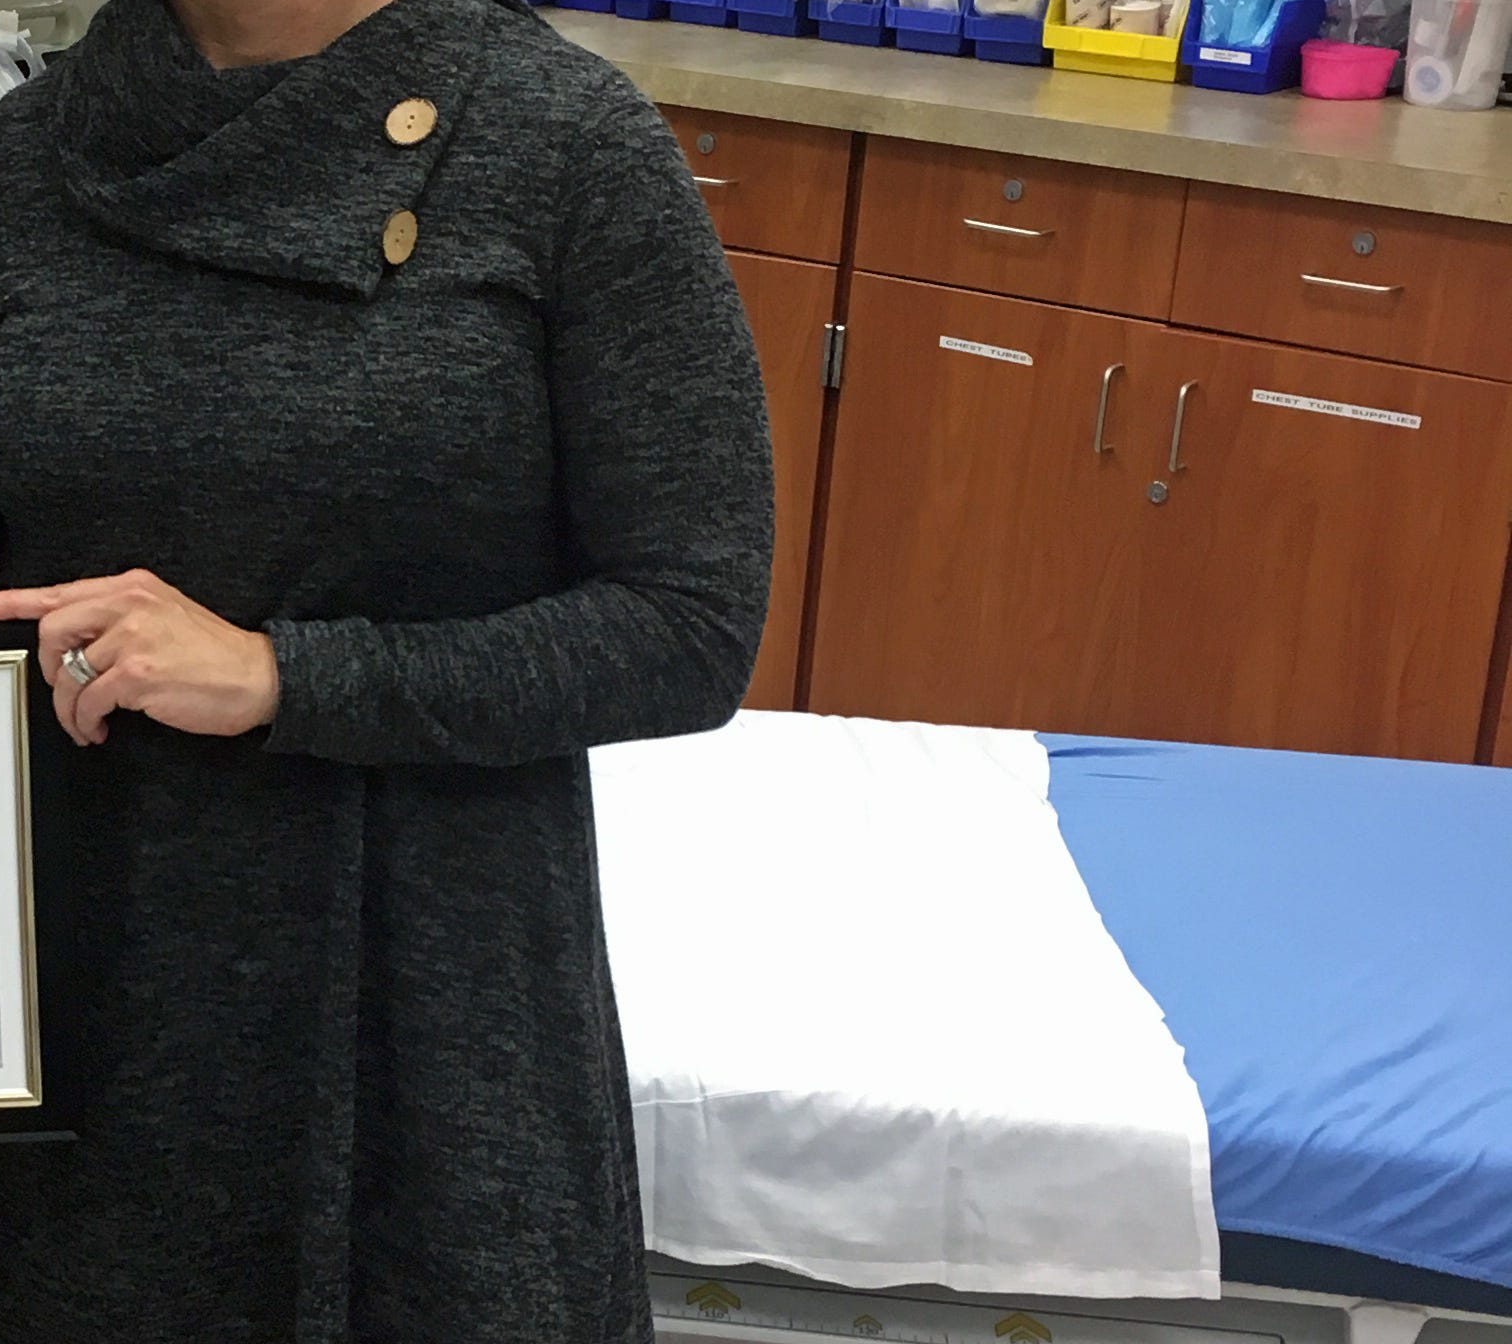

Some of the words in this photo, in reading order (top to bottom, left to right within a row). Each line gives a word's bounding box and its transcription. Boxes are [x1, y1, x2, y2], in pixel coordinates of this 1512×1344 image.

[945, 339, 983, 352] CHEST
[1255, 392, 1300, 406] CHEST
[1309, 402, 1343, 413] TUBE
[1351, 409, 1418, 425] SUPPLIES
